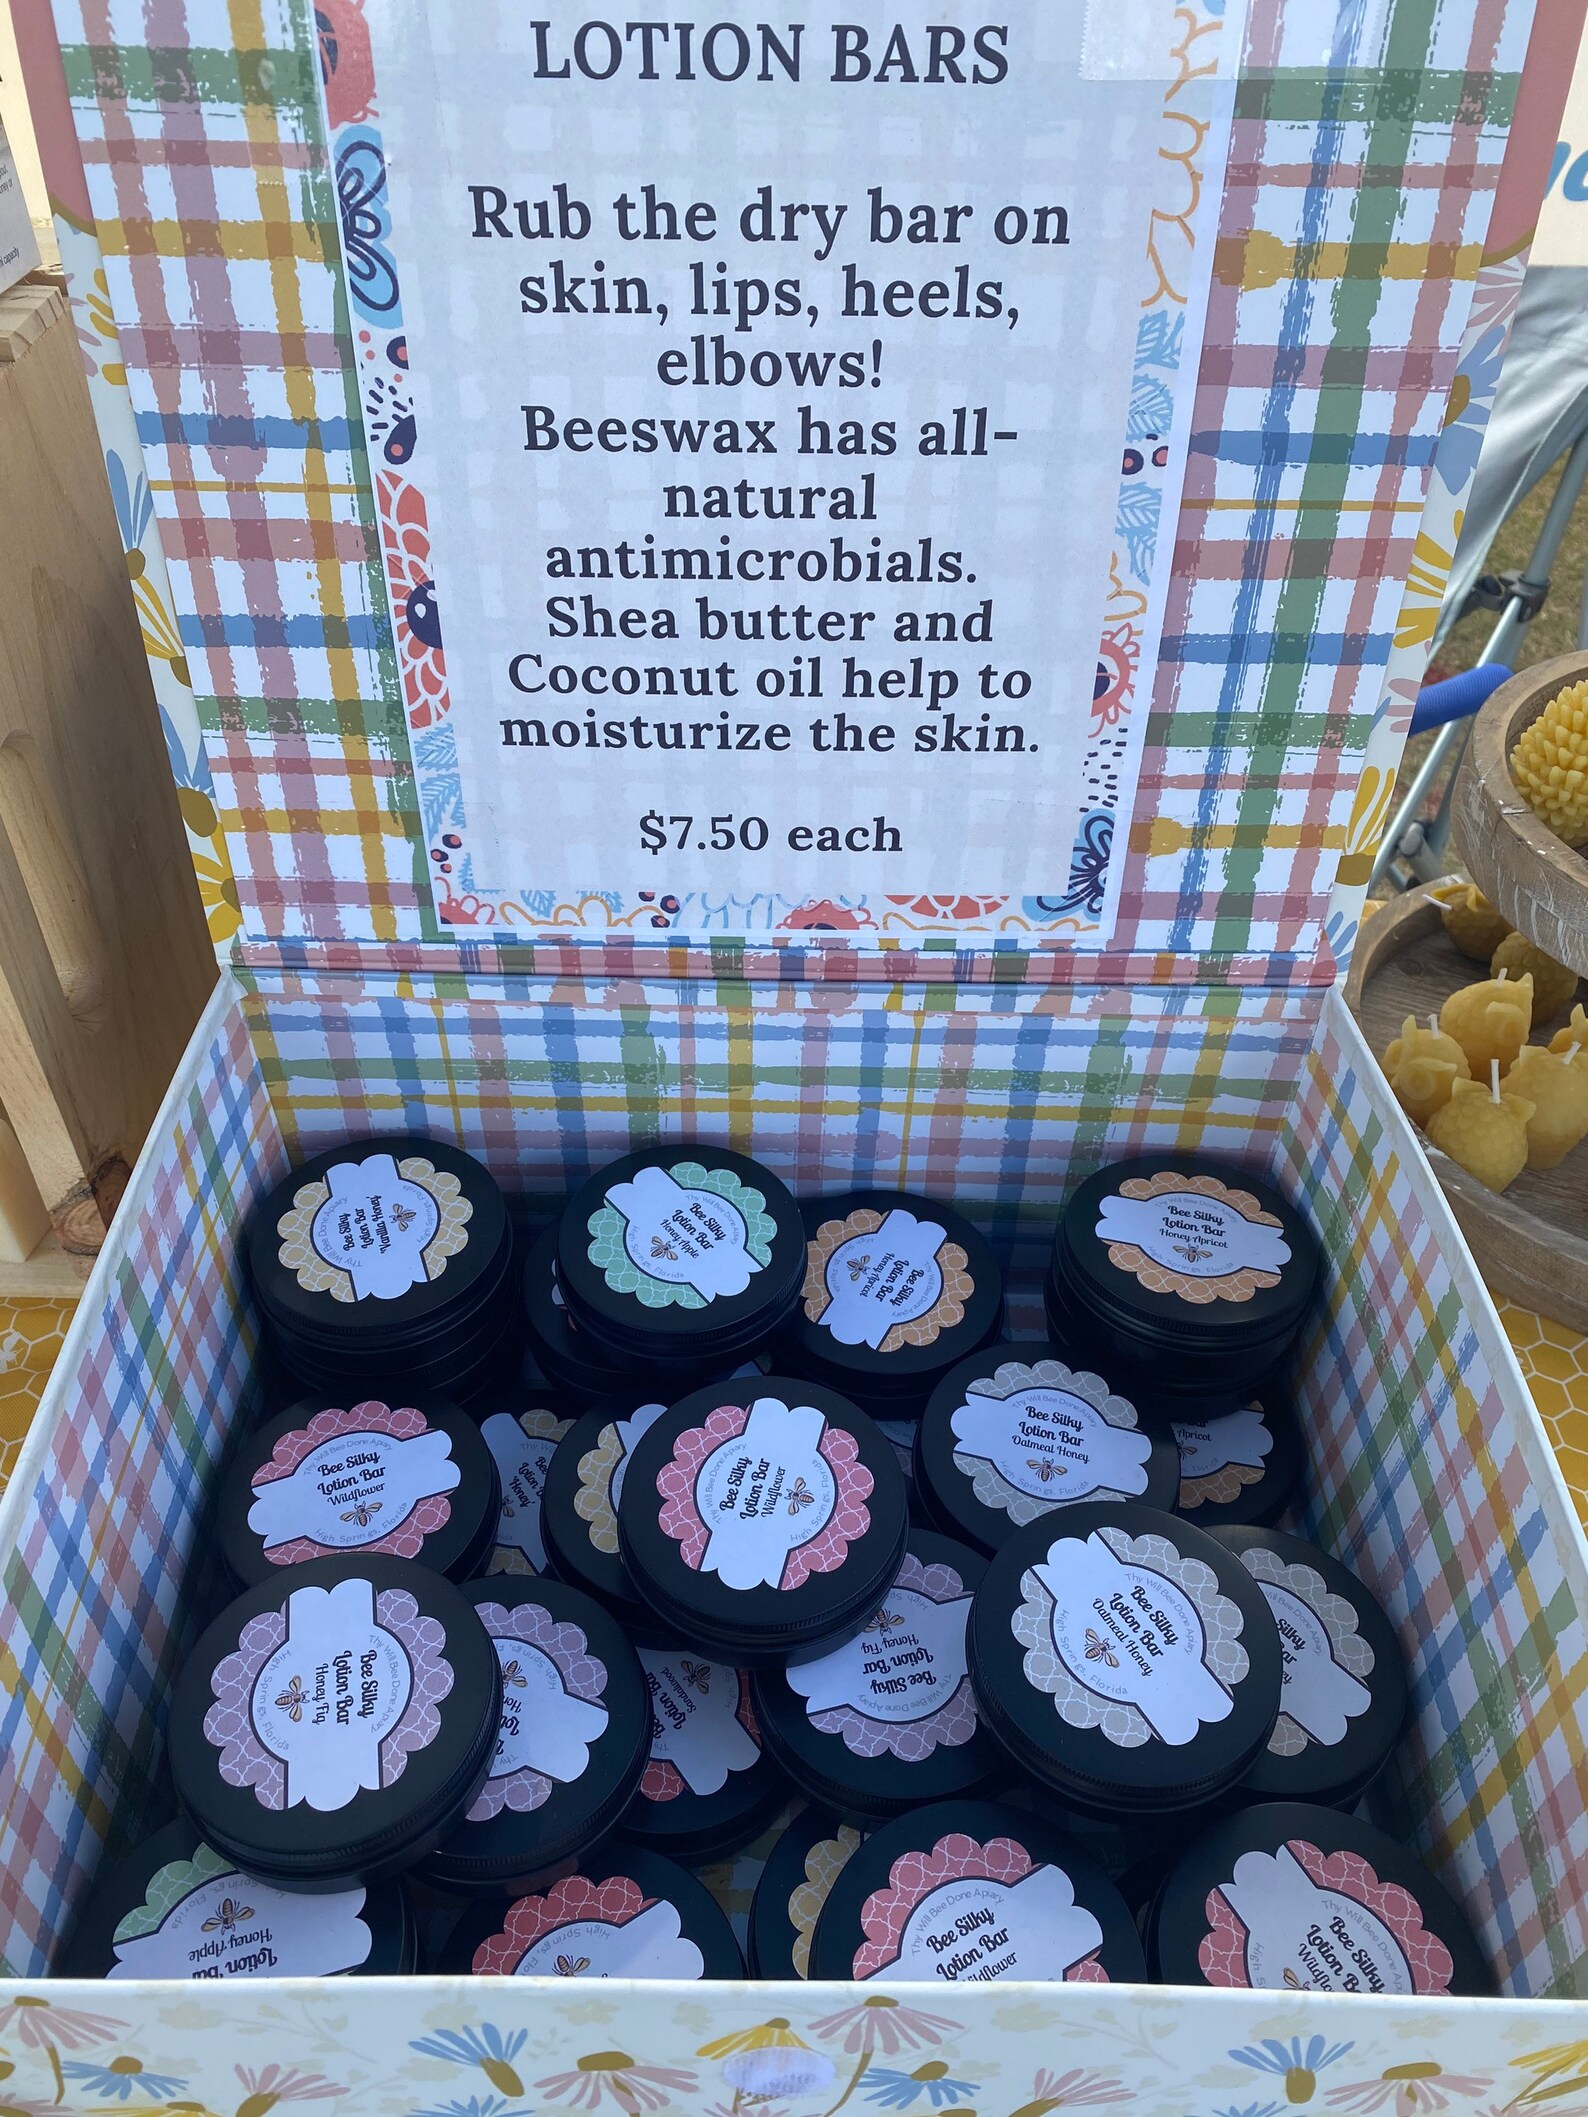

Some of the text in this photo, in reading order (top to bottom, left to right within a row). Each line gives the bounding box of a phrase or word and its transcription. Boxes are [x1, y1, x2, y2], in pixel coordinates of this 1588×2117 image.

[529, 20, 1009, 85] LOTION BARS
[467, 182, 1070, 261] Rub the dry bar on
[519, 259, 1019, 332] skin, lips, heels,
[657, 334, 883, 389] elbows!
[520, 404, 1018, 457] Beeswax has all-
[662, 472, 877, 521] natural
[546, 533, 977, 584] antimicrobials.
[546, 594, 993, 643] Shea butter and
[508, 653, 1032, 711] Coconut oil help to
[499, 708, 1039, 753] moisturize the skin.
[639, 809, 903, 856] $7.50 each
[338, 1213, 355, 1251] Bee Silky
[355, 1208, 374, 1249] Lotion Bar
[672, 1210, 714, 1250] Lotion Bar
[690, 1202, 726, 1240] Bee Silky
[1162, 1217, 1226, 1236] Lotion Bar
[1168, 1206, 1224, 1226] Bee Silky
[660, 1219, 699, 1258] Honey Apple
[1159, 1228, 1228, 1248] Honey Apricot
[875, 1260, 910, 1302] Lotion Bar
[890, 1269, 924, 1306] Bee Silky
[1018, 1422, 1084, 1446] Lotion Bar
[1026, 1406, 1084, 1432] Bee Silky
[1177, 1428, 1212, 1442] Apricot
[318, 1452, 380, 1476] Bee Silky
[1012, 1434, 1090, 1464] Oatmeal Honey
[317, 1466, 386, 1496] Lotion Bar
[326, 1482, 386, 1506] Wildflower
[518, 1462, 538, 1490] Lotion
[720, 1457, 752, 1510] Bee Silky
[740, 1458, 770, 1519] Lotion Bar
[761, 1466, 786, 1517] Wildflower
[1110, 1592, 1164, 1657] Lotion Bar
[1130, 1584, 1178, 1646] Bee Silky
[1276, 1618, 1306, 1650] Silky
[861, 1634, 919, 1655] Honey Fig
[1092, 1598, 1153, 1676] Oatmeal Honey
[863, 1647, 934, 1674] Lotion Bar
[312, 1663, 330, 1726] Honey Fig
[332, 1650, 354, 1726] Lotion Bar
[357, 1650, 378, 1718] Bee Silky
[870, 1670, 936, 1694] Bee Silky
[660, 1692, 686, 1730] Lotion
[928, 1901, 947, 1918] Bee
[946, 1890, 972, 1906] Done
[973, 1888, 1004, 1905] Apiary
[188, 1928, 272, 1962] Honey Apple
[926, 1908, 995, 1954] Bee Silky
[1306, 1924, 1344, 1976] Lotion
[225, 1947, 278, 1974] Lotion
[936, 1928, 1010, 1981] Lotion Bar
[1329, 1916, 1355, 1950] Bee
[1352, 1948, 1385, 1994] Silky
